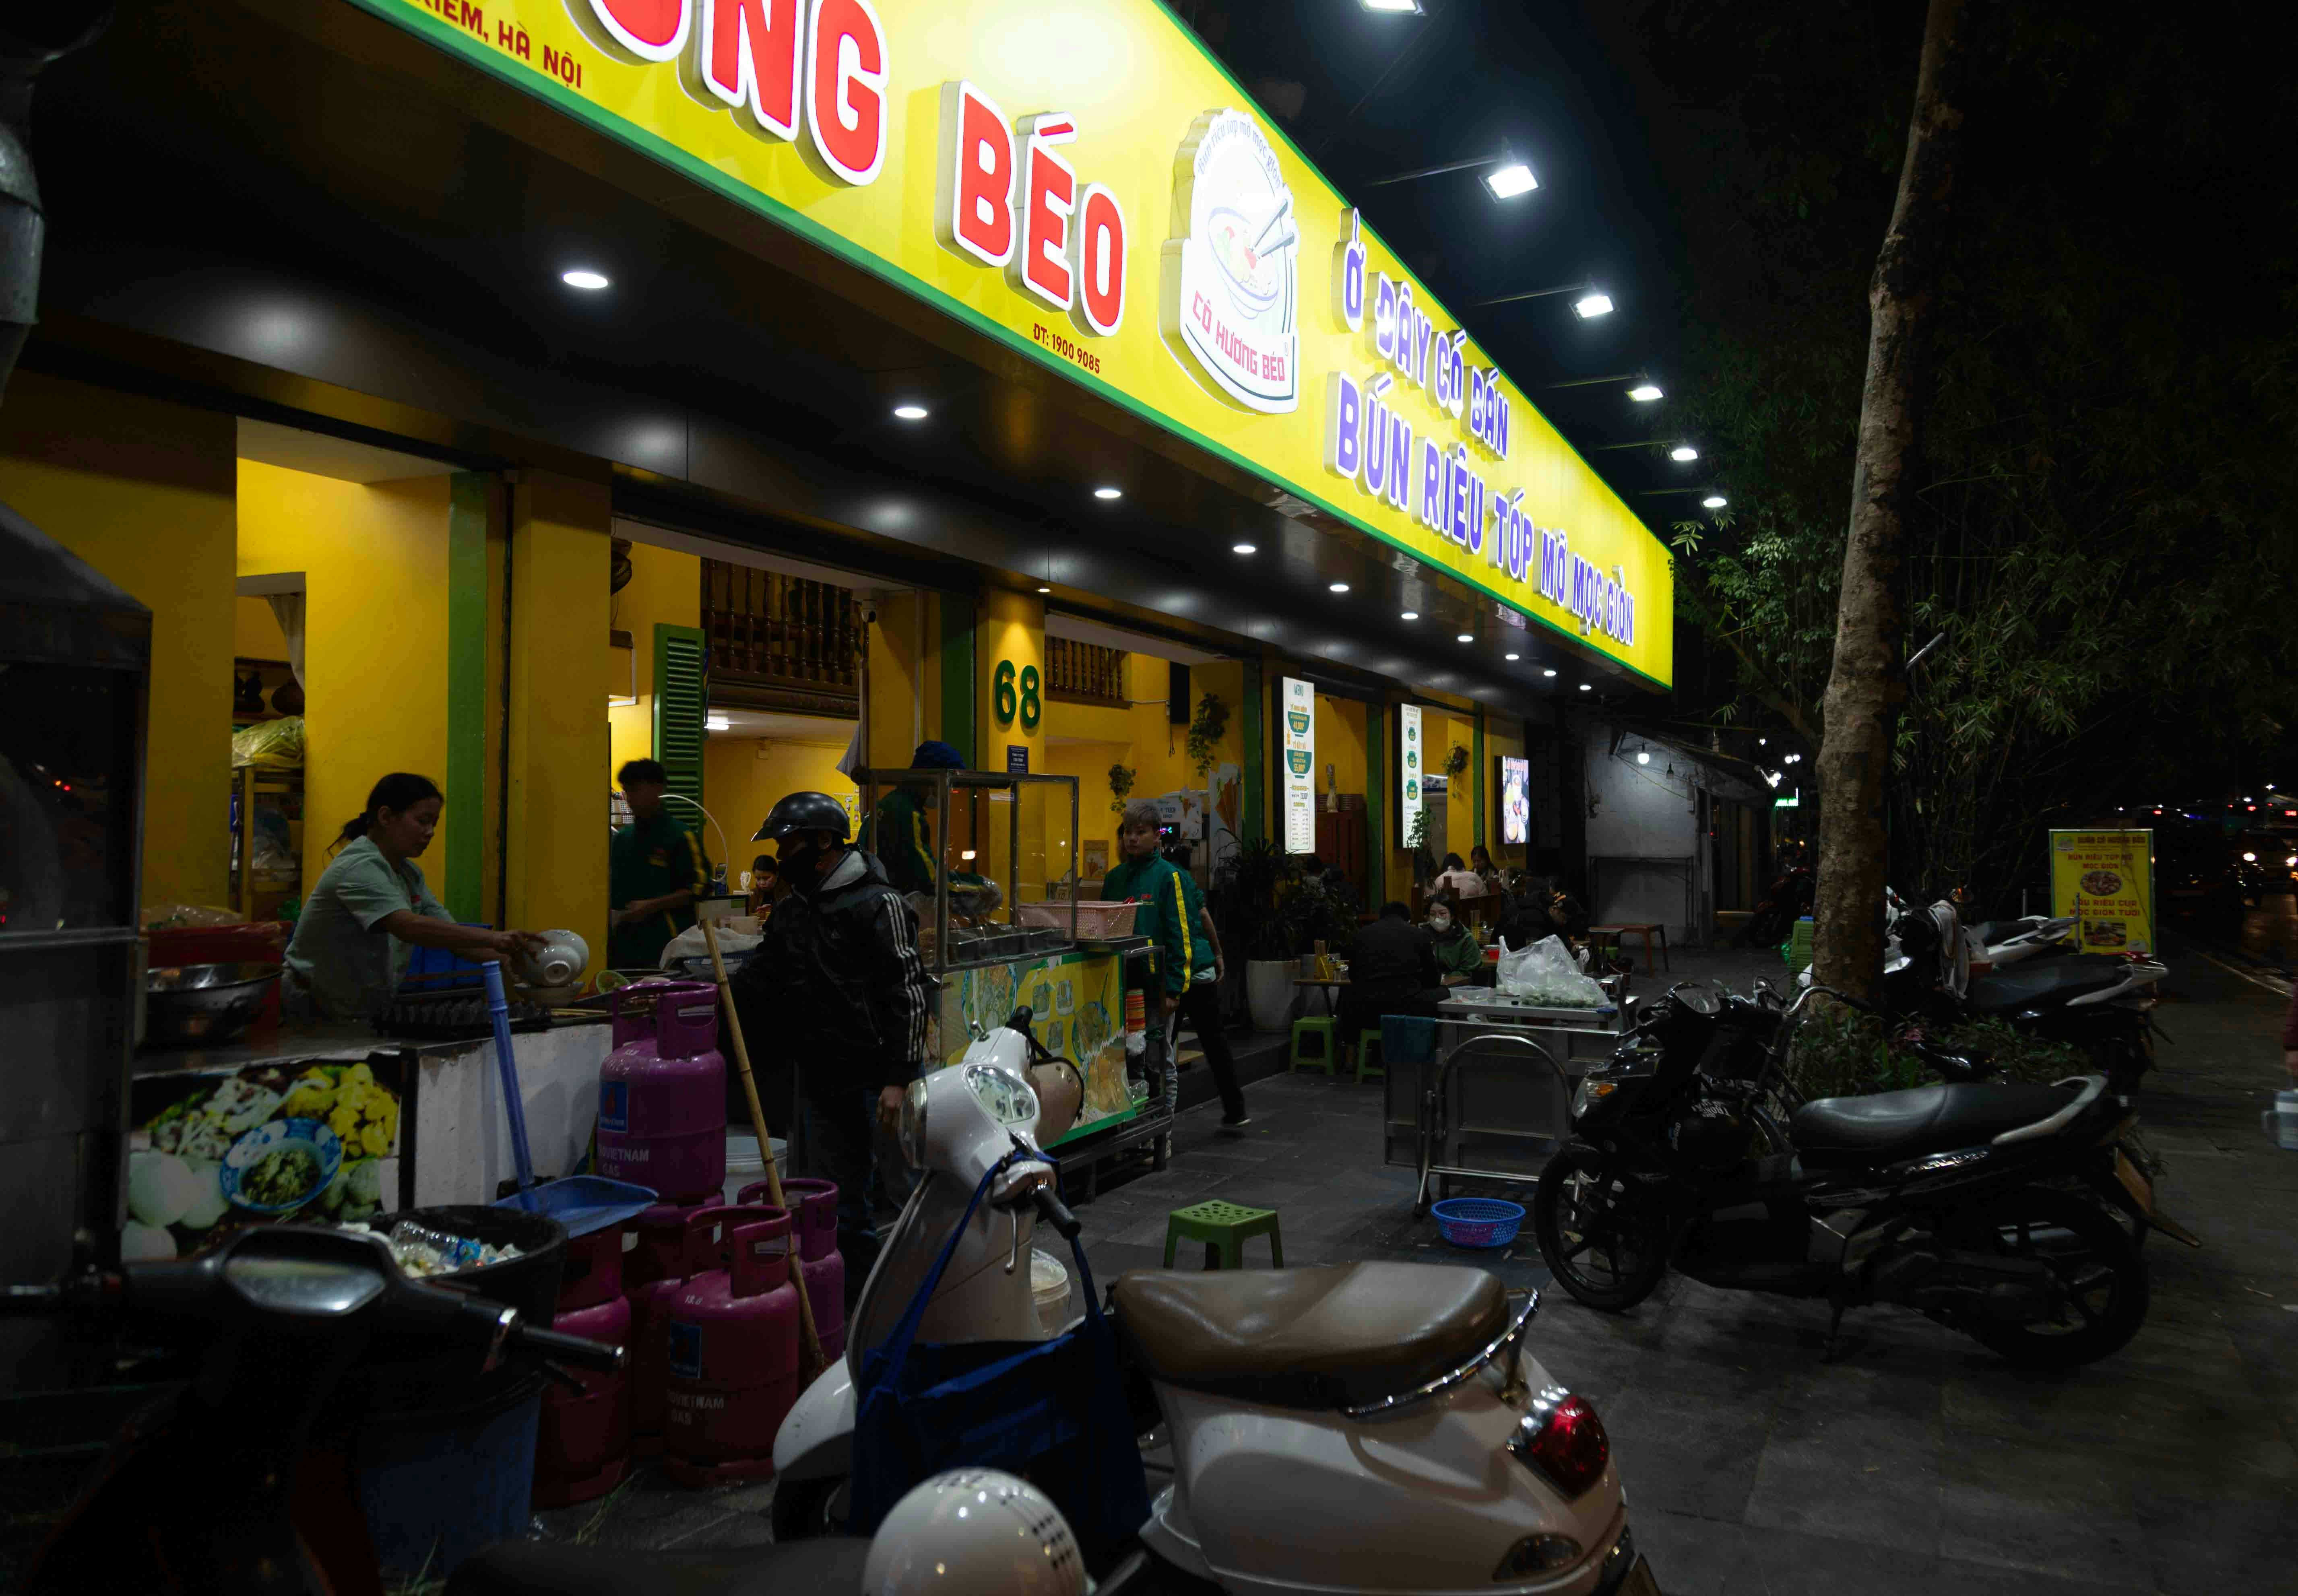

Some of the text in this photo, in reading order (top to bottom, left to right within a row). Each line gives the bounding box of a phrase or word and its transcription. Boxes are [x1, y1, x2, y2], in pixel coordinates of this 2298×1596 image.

[499, 20, 530, 60] HÀ
[543, 44, 581, 89] NỘI
[598, 0, 888, 186] NG
[952, 80, 1127, 336] BÉO
[1033, 323, 1100, 373] ĐT: 1900 9085
[1193, 289, 1285, 381] CÔ HƯƠNG BÉO
[1376, 271, 1432, 389] ĐÂY
[1435, 329, 1466, 419] CÓ
[1470, 366, 1509, 461] BÁN
[1336, 371, 1412, 512] BÚN
[1422, 436, 1485, 554] RIÊU
[1495, 488, 1534, 583] TÓP
[1572, 552, 1603, 635] MỌC
[1606, 566, 1634, 647] GIÒN
[993, 659, 1041, 729] 68
[1294, 683, 1304, 697] MENU
